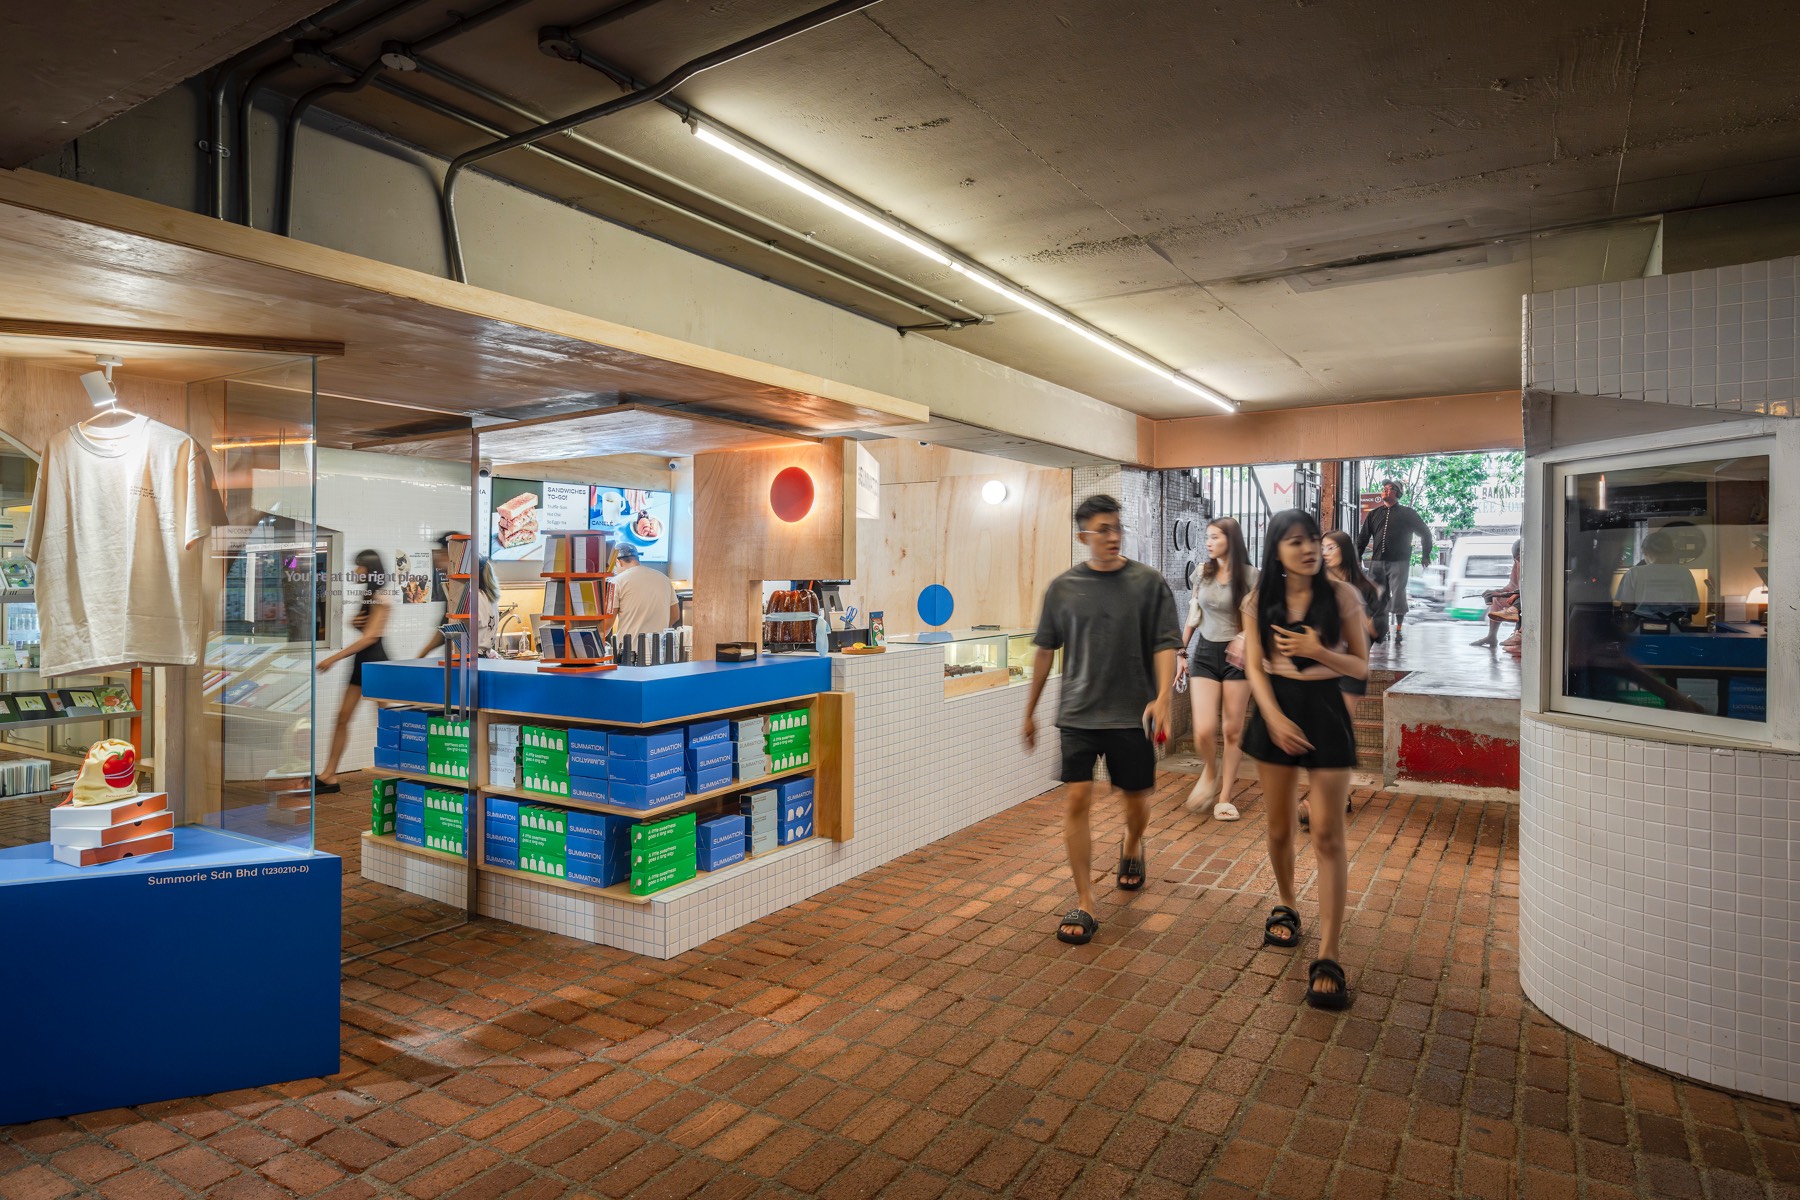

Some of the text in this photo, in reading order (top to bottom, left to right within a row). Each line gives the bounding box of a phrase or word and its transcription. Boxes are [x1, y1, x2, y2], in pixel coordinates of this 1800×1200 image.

[548, 486, 586, 495] SANDWICHES
[331, 572, 343, 582] at
[346, 570, 367, 582] the
[368, 570, 396, 585] right
[692, 732, 727, 744] SUMMATION
[571, 742, 605, 752] SUMMATION
[650, 743, 682, 756] SUMMATION
[571, 756, 605, 765] SUMMATION
[700, 755, 731, 767] SUMMATION
[650, 767, 682, 780] SUMMATION
[700, 777, 730, 790] SUMMATION
[572, 789, 605, 800] SUMMATION
[649, 791, 684, 806] SUMMATION
[787, 790, 812, 802] SUMMATION
[487, 811, 516, 820] SUMMATION
[570, 825, 602, 836] SUMMATION
[659, 823, 677, 832] sweetness
[486, 833, 516, 843] SUMMATION
[713, 831, 743, 844] SUMMATION
[568, 849, 601, 860] SUMMATION
[660, 846, 677, 854] sweetness
[486, 855, 515, 866] SUMMATION
[713, 852, 743, 867] SUMMATION
[148, 865, 309, 885] Summorie Sdn Bhd (1230210-D)
[660, 868, 677, 876] sweetness
[568, 872, 601, 884] SUMMATION
